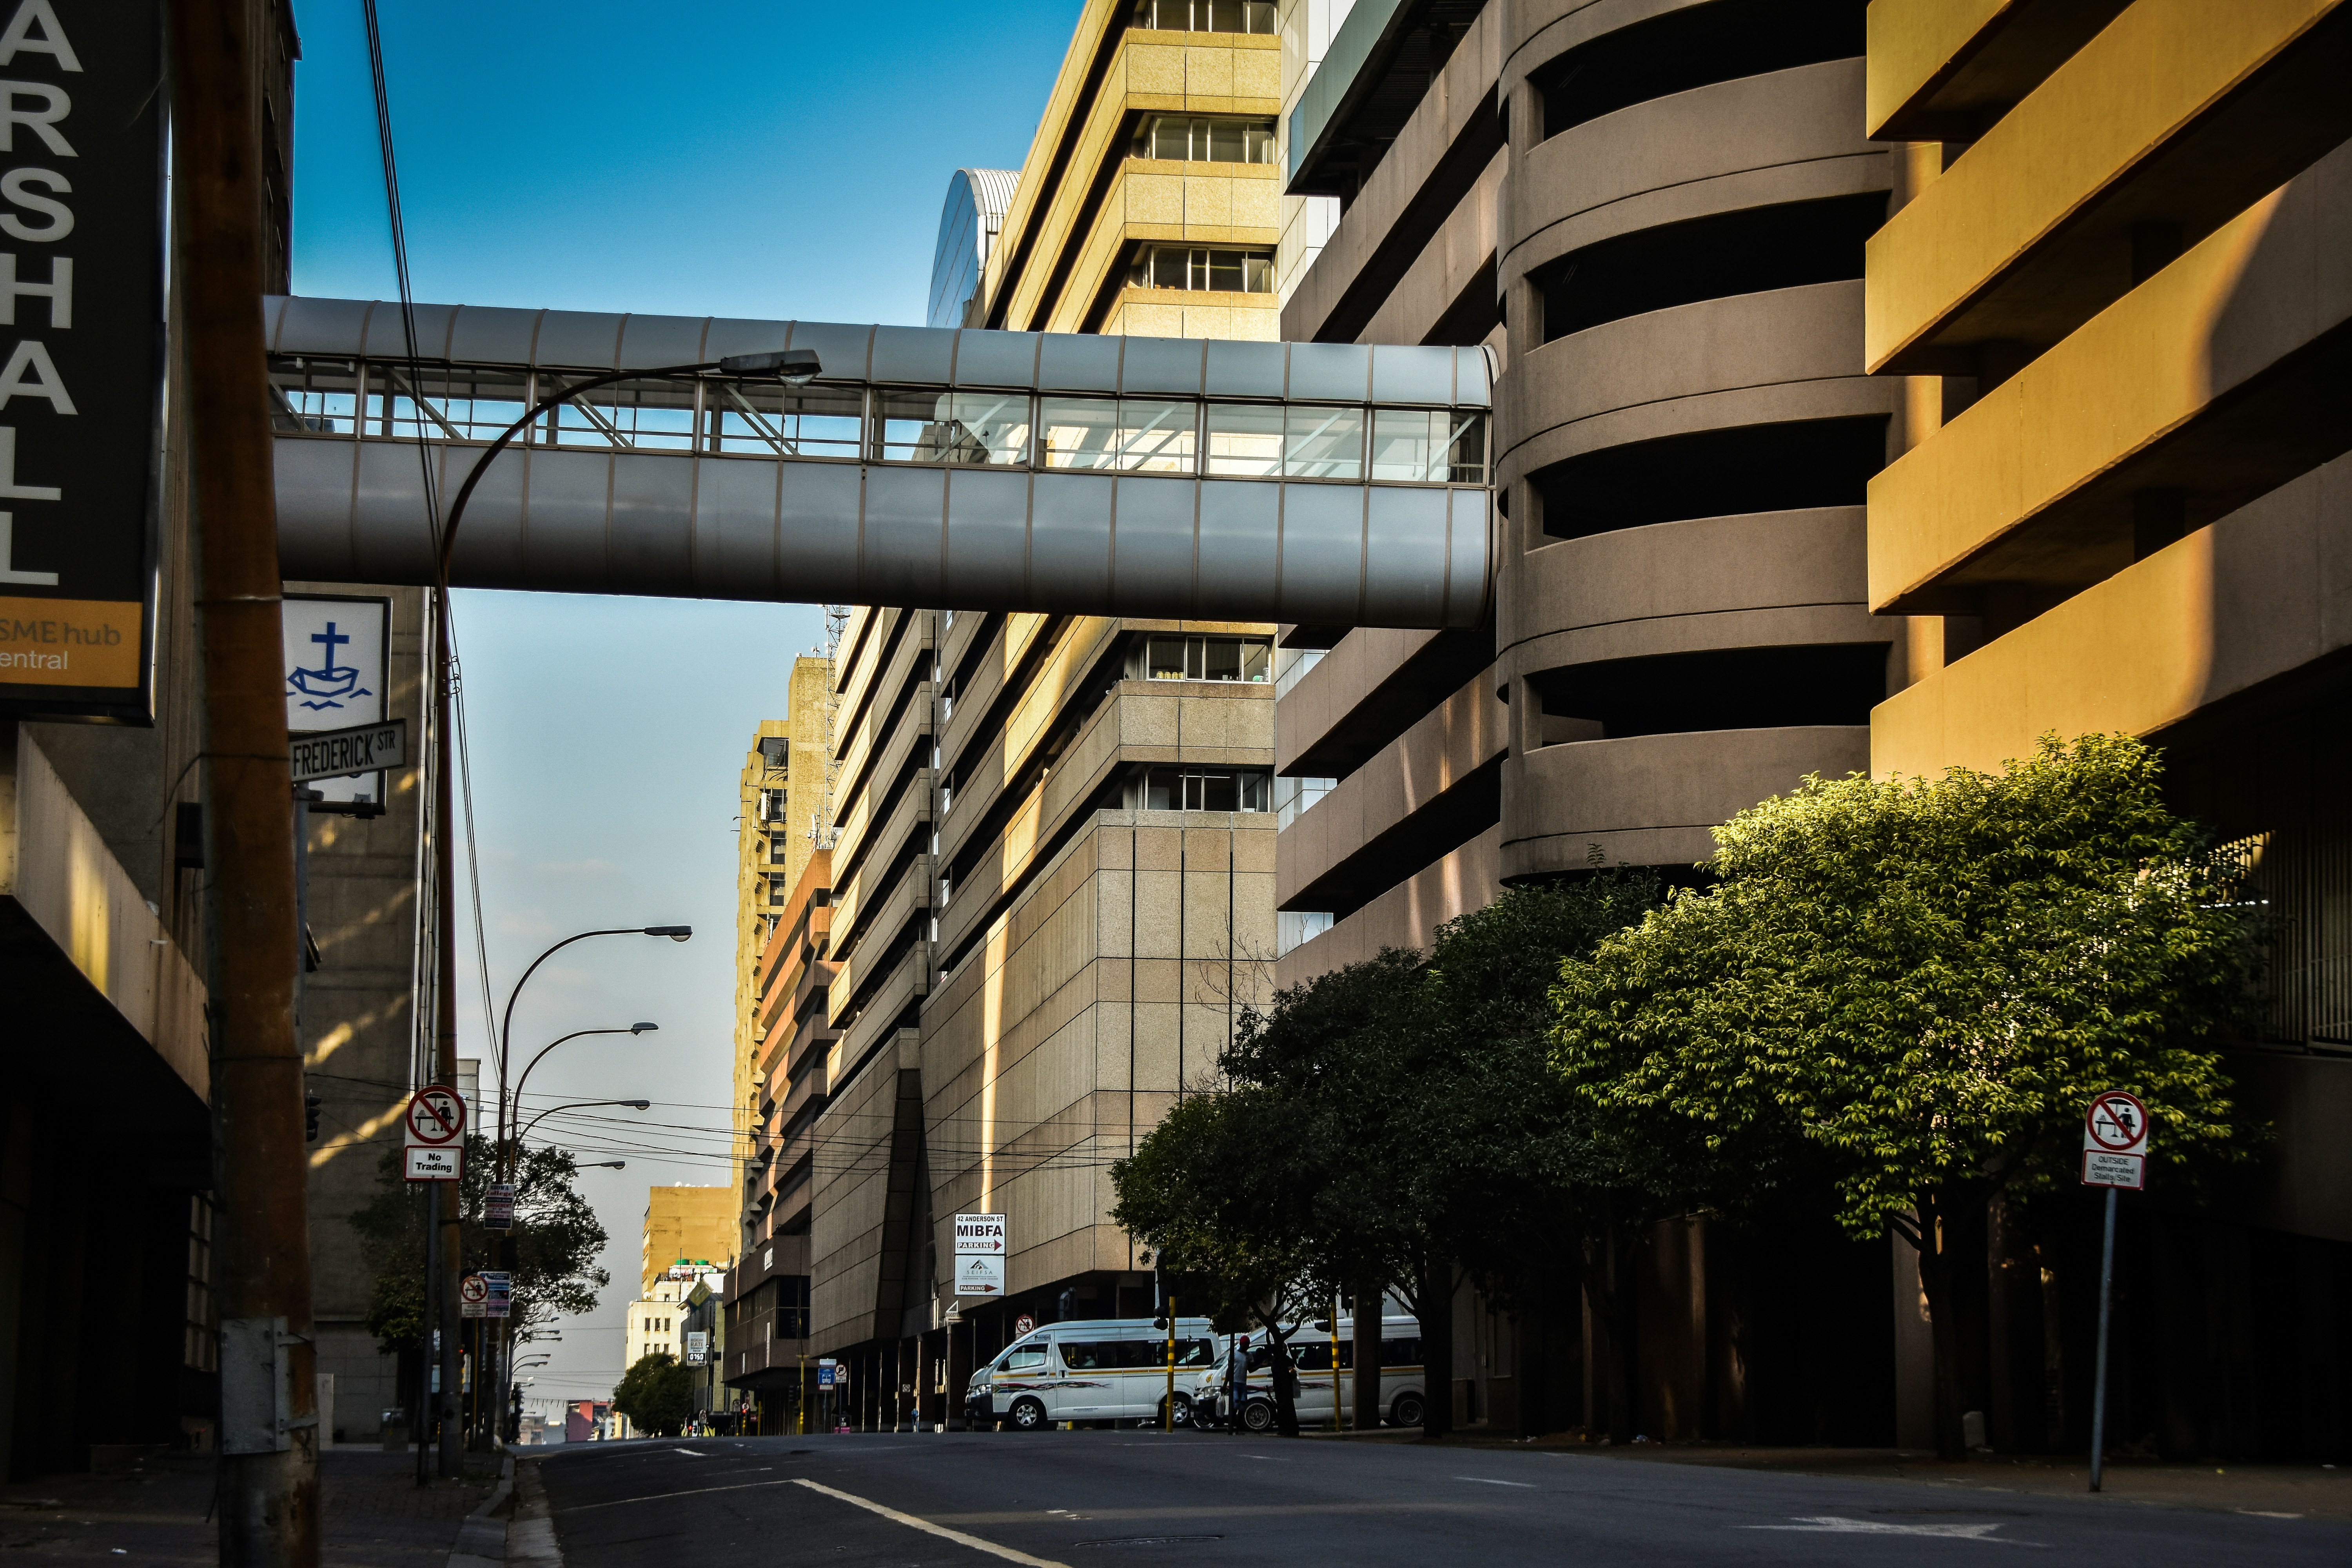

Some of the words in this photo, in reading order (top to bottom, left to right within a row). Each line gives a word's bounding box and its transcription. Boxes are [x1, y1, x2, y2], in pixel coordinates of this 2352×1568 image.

[293, 734, 374, 777] FREDERICK
[378, 730, 395, 751] STR
[2098, 1156, 2129, 1165] OUTSIDE
[416, 1162, 452, 1172] Trading
[2092, 1163, 2134, 1174] Demarcated
[957, 1225, 1003, 1236] MIBFA
